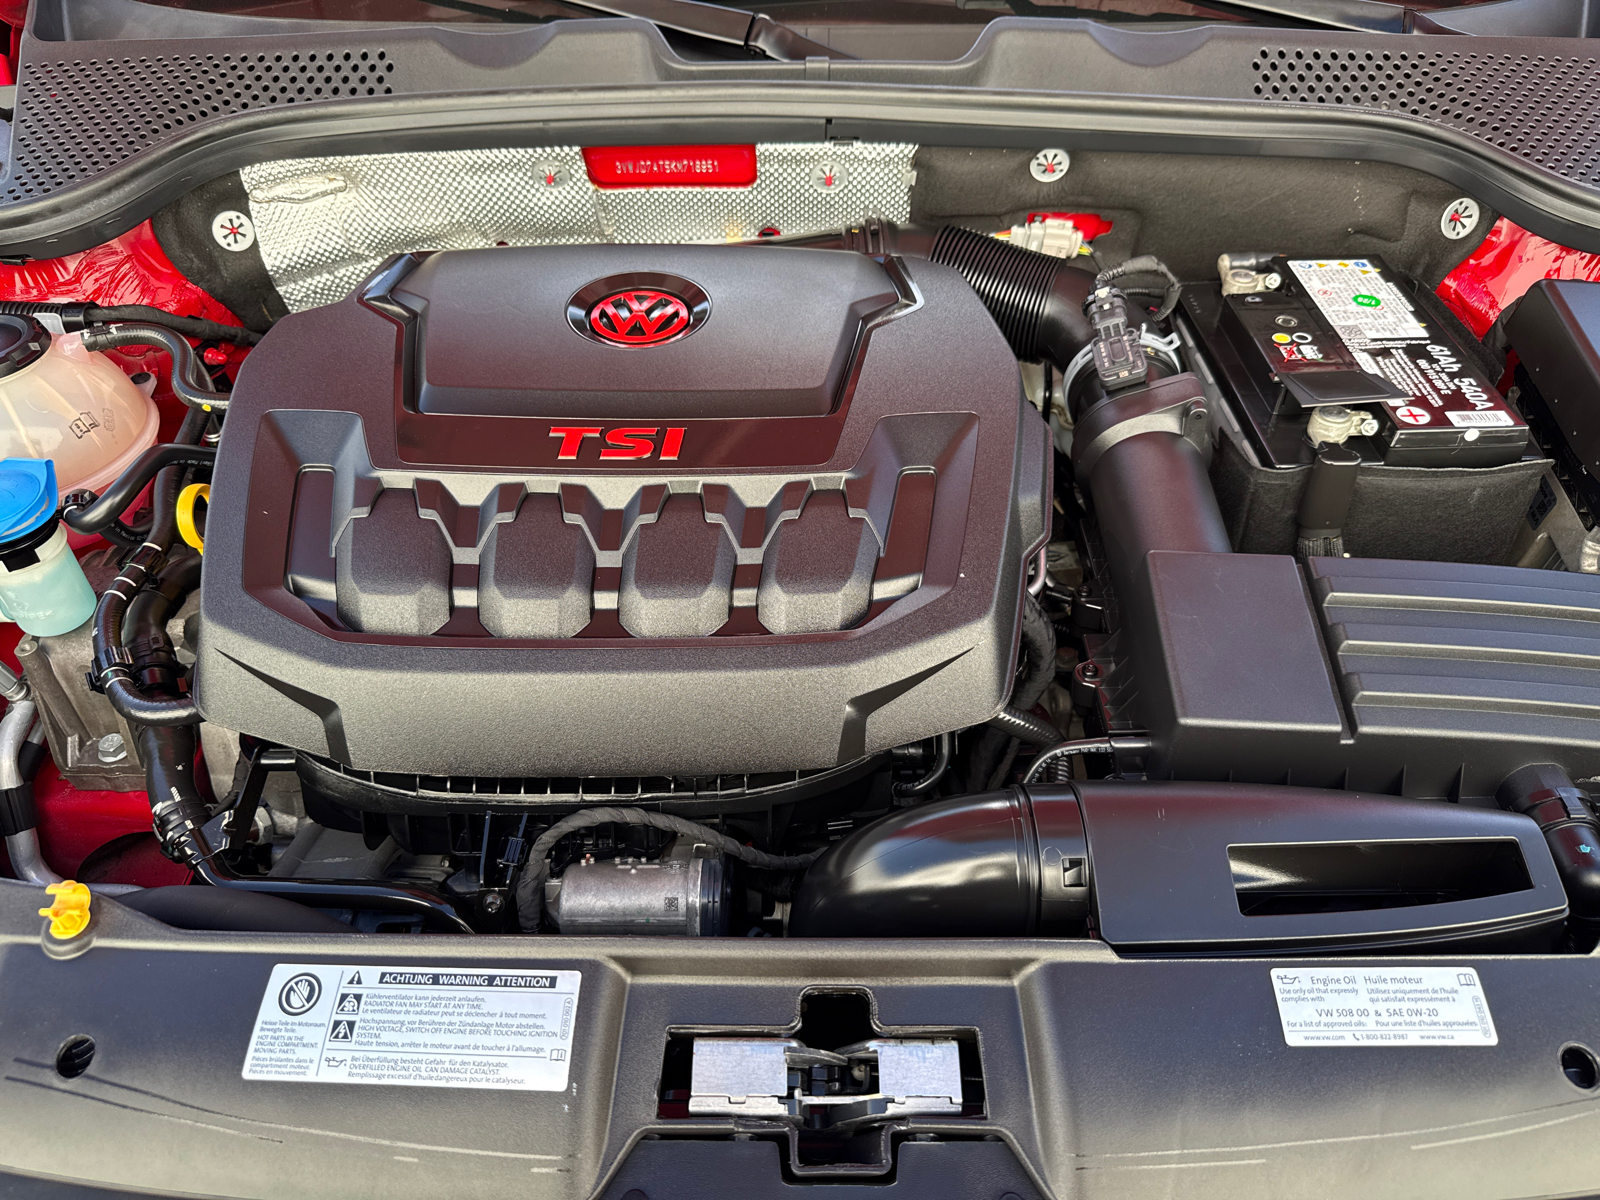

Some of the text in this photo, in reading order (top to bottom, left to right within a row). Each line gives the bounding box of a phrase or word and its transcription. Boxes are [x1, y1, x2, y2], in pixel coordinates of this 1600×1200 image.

[1426, 344, 1462, 372] 61Ah
[1454, 378, 1494, 410] 540A
[548, 426, 687, 460] TSI
[382, 974, 550, 987] ACHTUNG WARNING ATTENTION
[1310, 976, 1341, 987] Engine
[1343, 976, 1356, 984] Oil
[1364, 976, 1388, 984] Huile
[1315, 1009, 1333, 1017] VW
[1336, 1009, 1354, 1017] 508
[1356, 1008, 1369, 1017] 00
[1386, 1008, 1404, 1017] SAE
[1406, 1008, 1438, 1017] 0W-20
[359, 1018, 406, 1027] Hochspannung,
[362, 1055, 399, 1065] Überfüllung
[347, 1071, 386, 1080] Remplissage
[435, 1074, 467, 1083] dangereux
